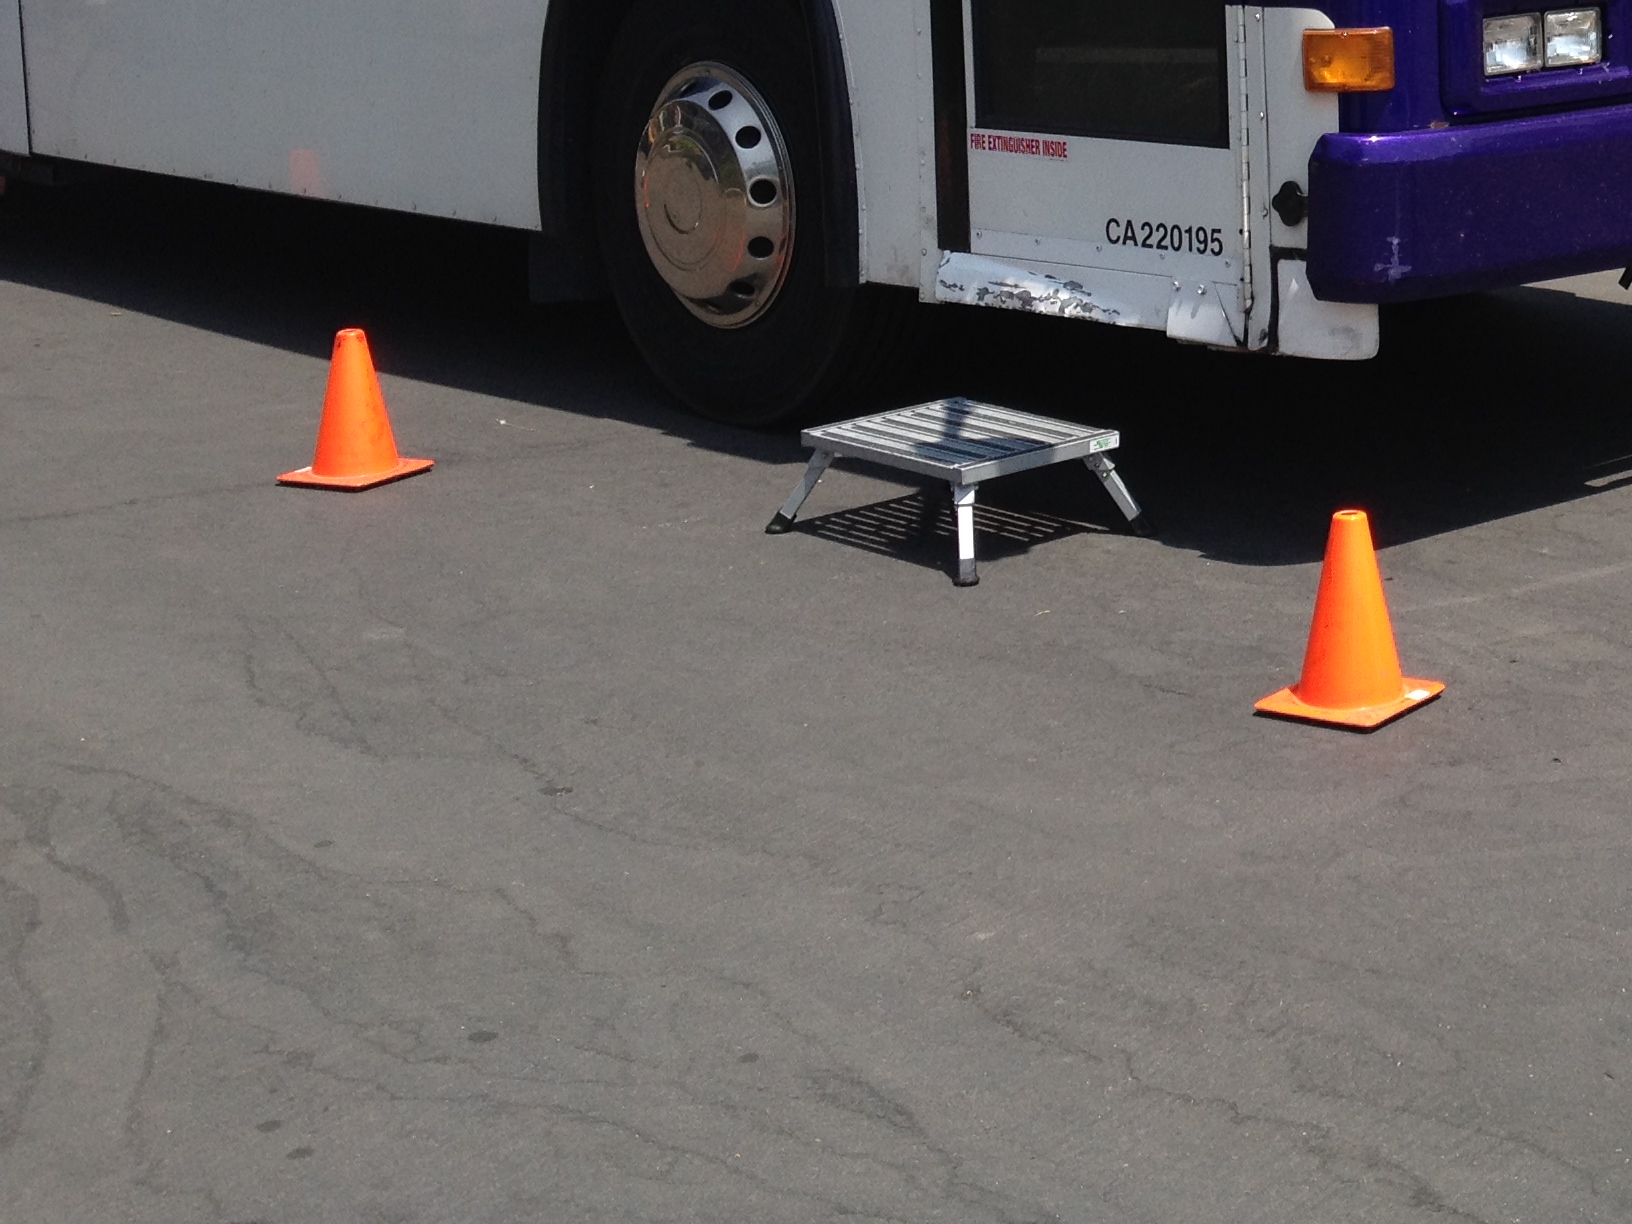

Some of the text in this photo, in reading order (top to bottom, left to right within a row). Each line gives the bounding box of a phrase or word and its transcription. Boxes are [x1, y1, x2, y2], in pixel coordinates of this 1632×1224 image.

[970, 133, 1068, 158] FIRE EXTINGUISHER INSIDE
[1105, 217, 1224, 257] CA220195
